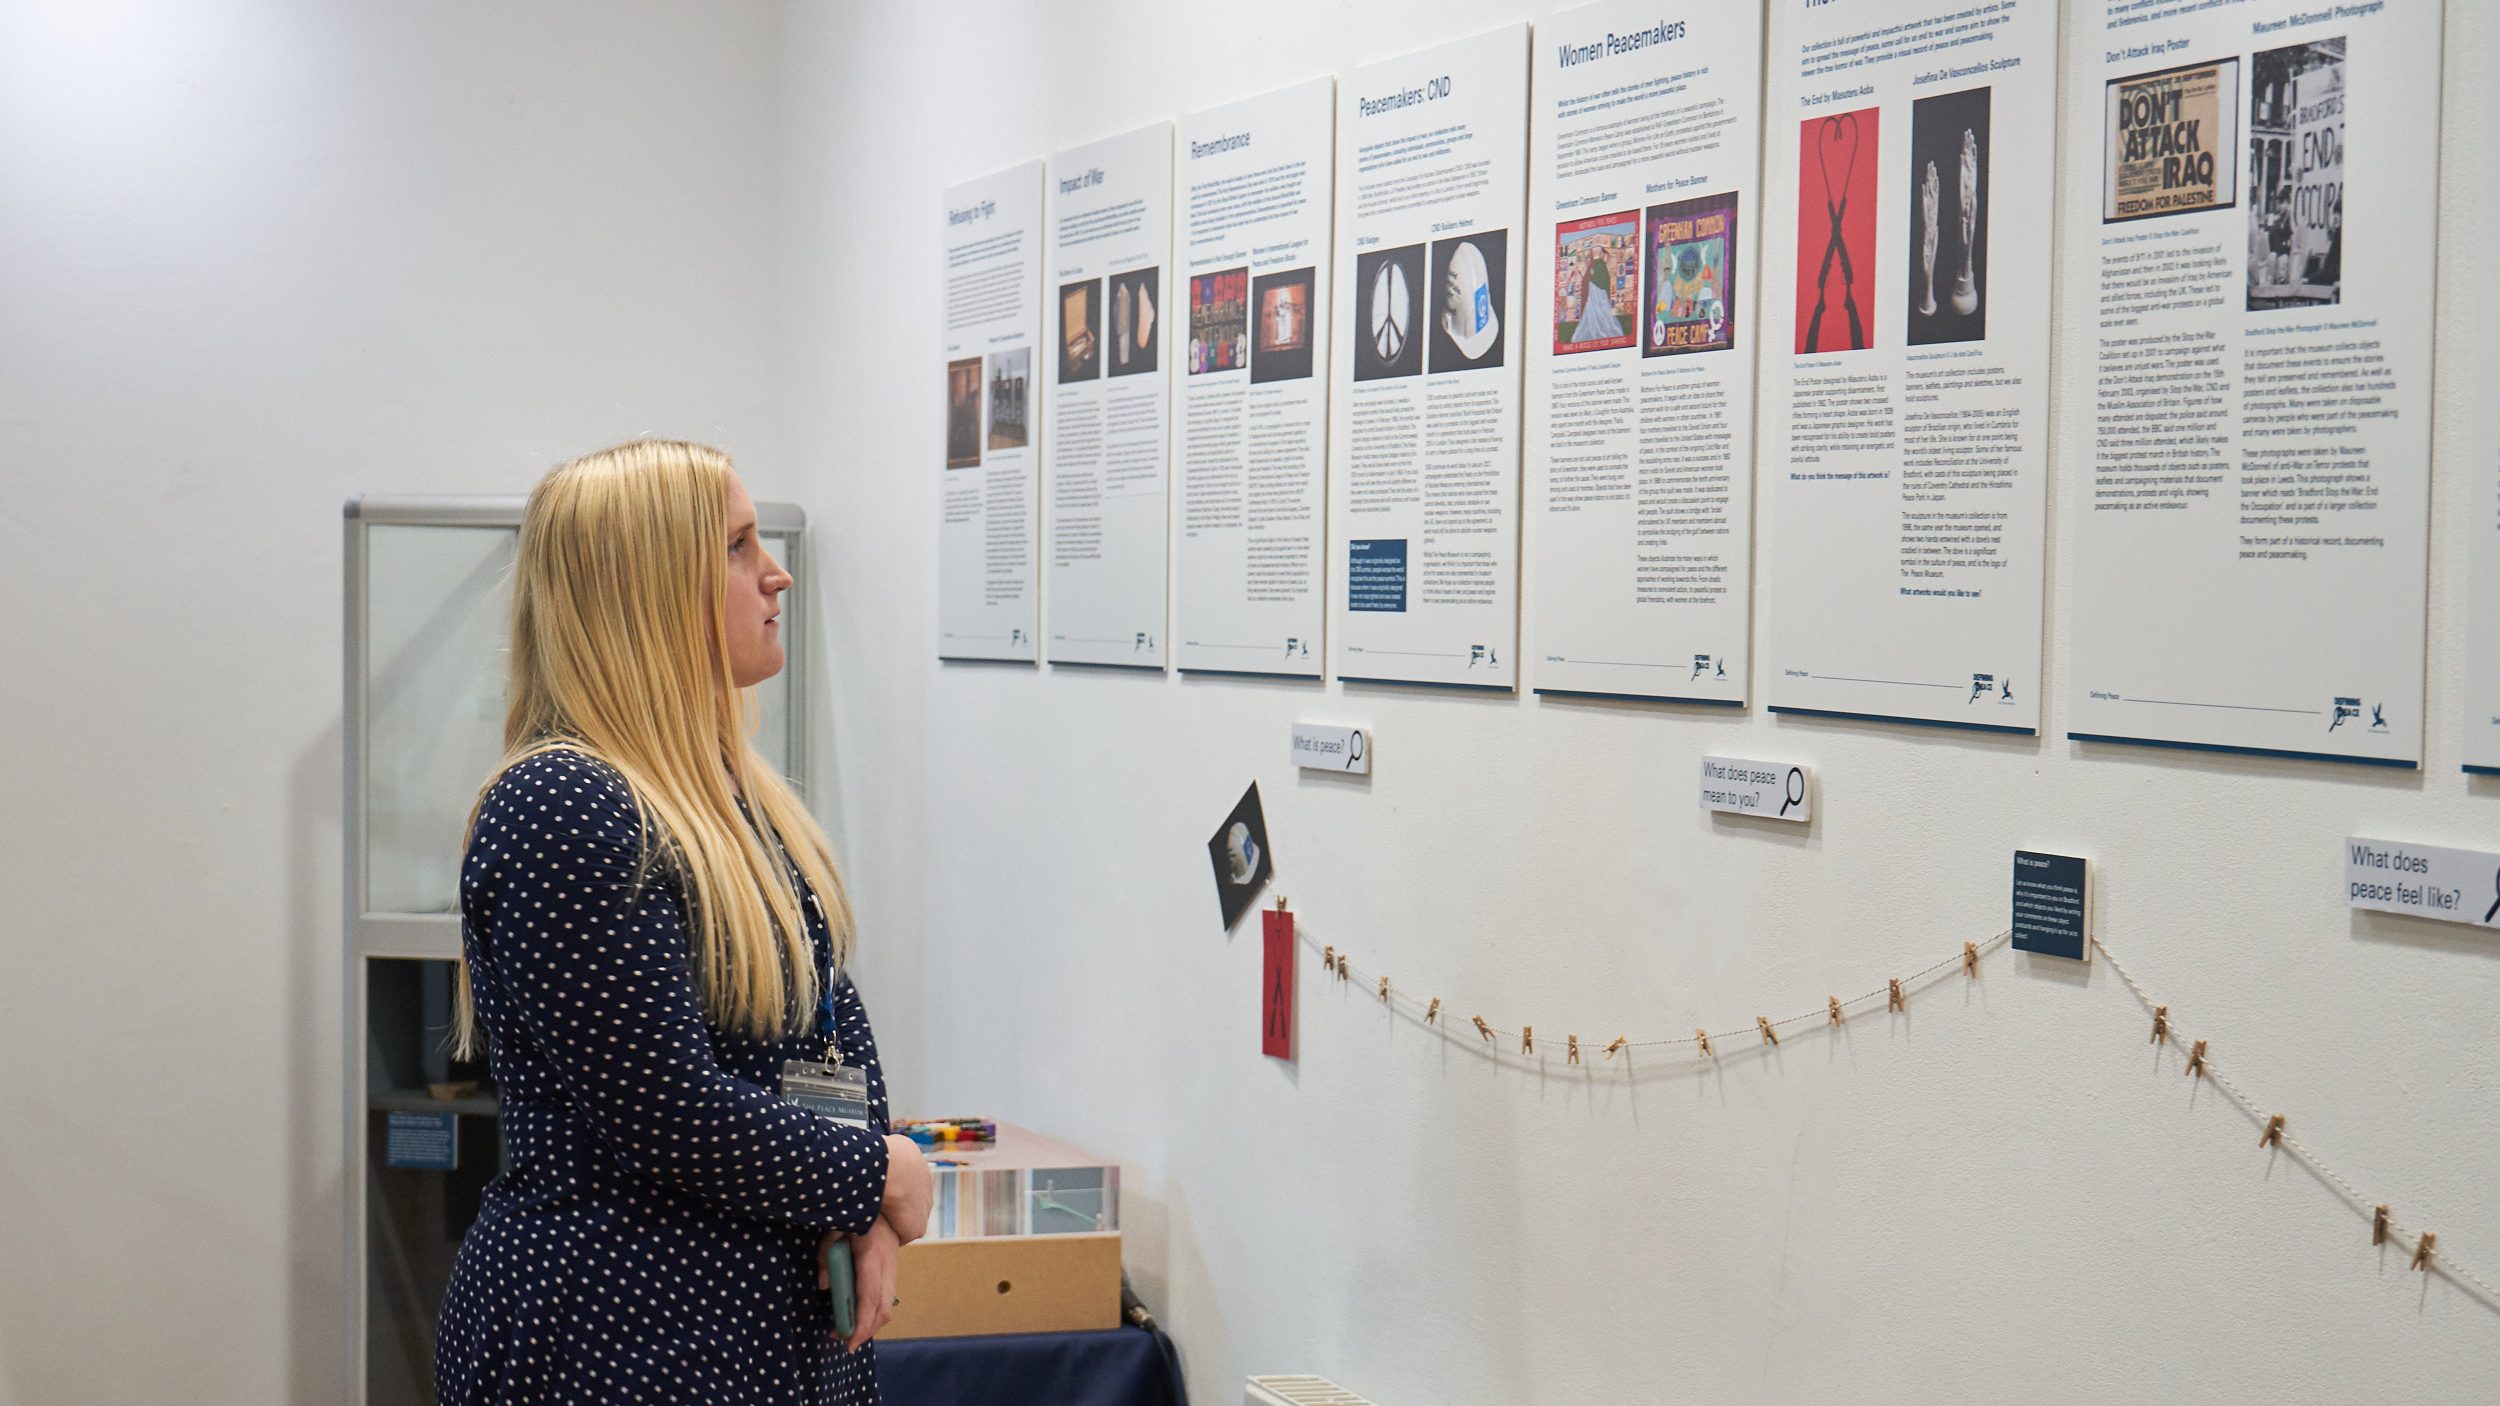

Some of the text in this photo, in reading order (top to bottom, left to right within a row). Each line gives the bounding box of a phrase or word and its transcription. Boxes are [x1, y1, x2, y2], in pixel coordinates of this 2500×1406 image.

[1558, 19, 1686, 68] Women Peacemakers
[1360, 76, 1451, 118] Peacemakers: CND
[2120, 89, 2184, 130] DON'T
[1191, 132, 1250, 159] Remembrance
[2124, 120, 2200, 162] ATTACK
[2303, 127, 2335, 173] END
[2162, 151, 2214, 189] IRAQ
[2118, 190, 2213, 213] FREEDOM FOR PALESTINE
[1666, 324, 1709, 345] PEACE CAMP
[1294, 736, 1345, 756] What is peace?
[1704, 762, 1776, 786] What does peace
[1703, 790, 1760, 809] mean to you?
[2351, 845, 2428, 874] What does
[2351, 881, 2461, 910] peace feel like?
[817, 1104, 836, 1113] PEACE
[838, 1106, 864, 1116] MUSEUM
